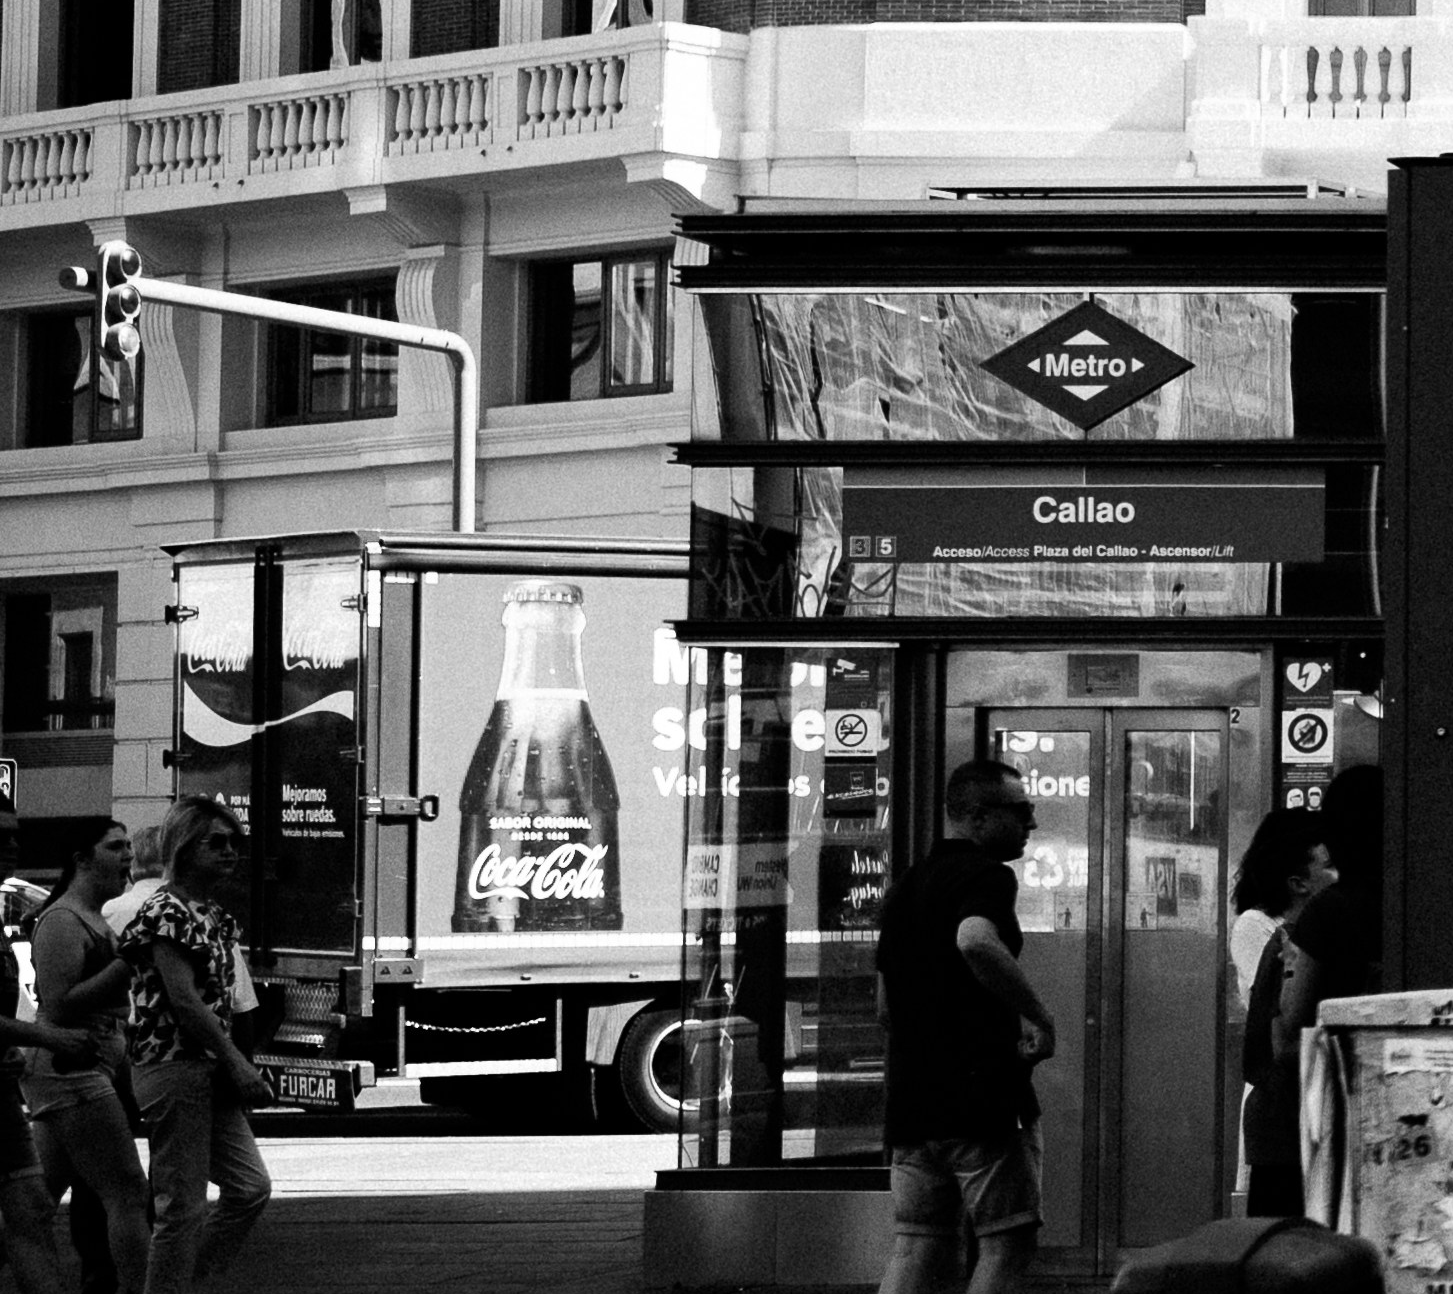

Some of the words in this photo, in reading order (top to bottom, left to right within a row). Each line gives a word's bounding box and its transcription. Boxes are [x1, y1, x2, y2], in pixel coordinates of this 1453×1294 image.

[1045, 353, 1126, 377] Metro
[1033, 496, 1136, 524] Callao
[879, 537, 892, 556] 5
[933, 545, 1029, 558] Acceso/Access
[1033, 545, 1069, 557] Plaza
[1072, 545, 1093, 557] del
[1096, 545, 1138, 557] Callao
[1149, 544, 1234, 557] Ascensor/Lift
[282, 784, 327, 805] Mejoramos
[282, 806, 304, 822] sobre
[305, 806, 336, 823] ruedas.
[488, 816, 532, 829] SABOR
[532, 816, 593, 829] ORIGINAL
[468, 843, 609, 900] Coca-Cola
[280, 1074, 336, 1099] FURCAR
